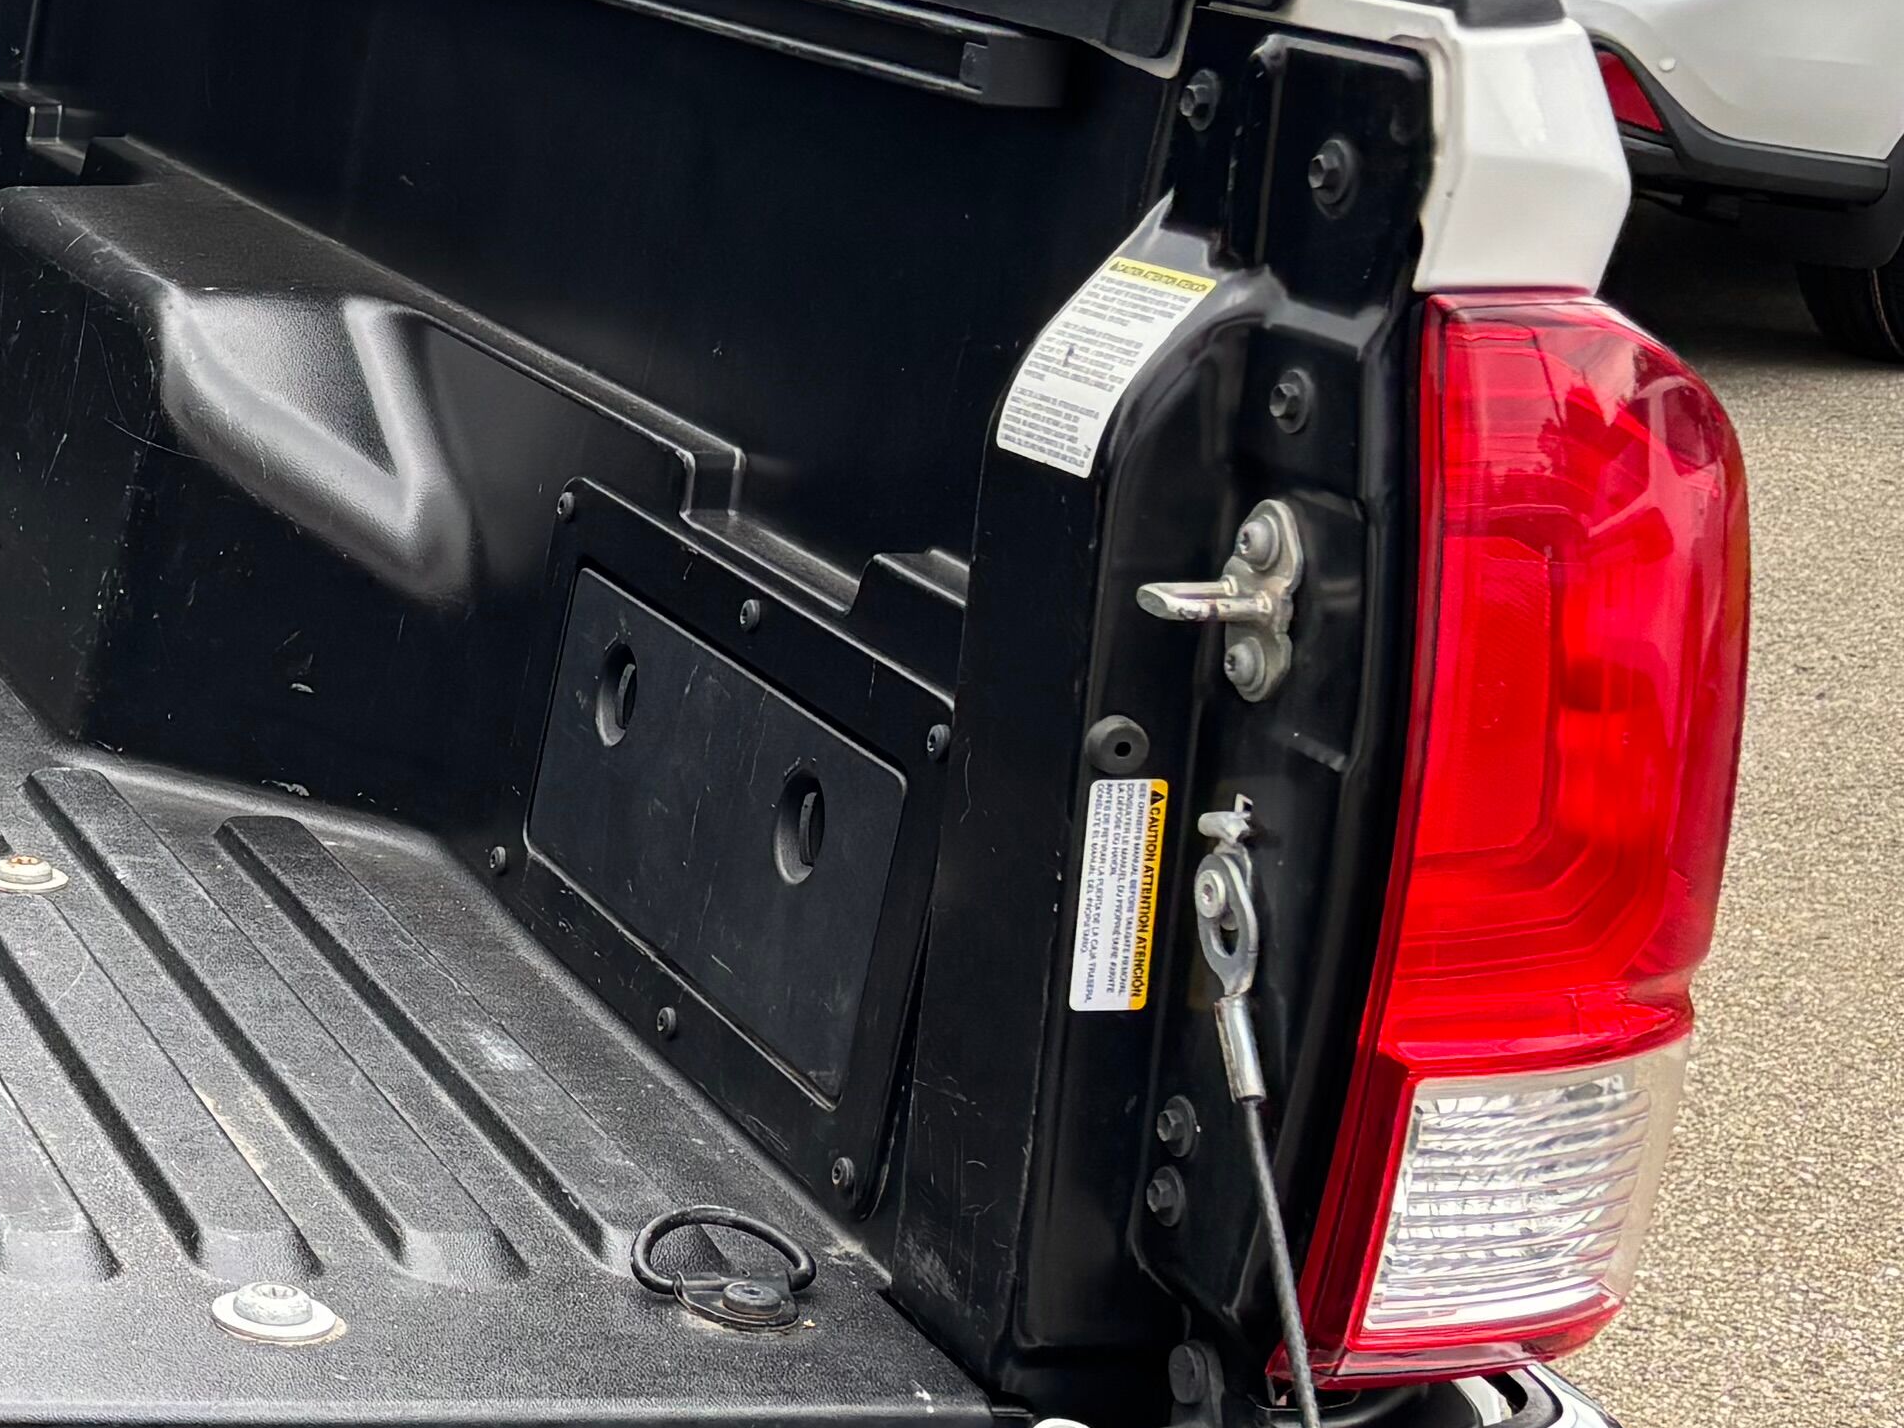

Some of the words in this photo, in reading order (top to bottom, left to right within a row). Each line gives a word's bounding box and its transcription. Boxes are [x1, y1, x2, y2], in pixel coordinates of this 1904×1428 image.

[1144, 807, 1160, 862] CAUTION
[1137, 865, 1154, 933] ATTENTION
[1131, 936, 1146, 998] ATENCIÓN
